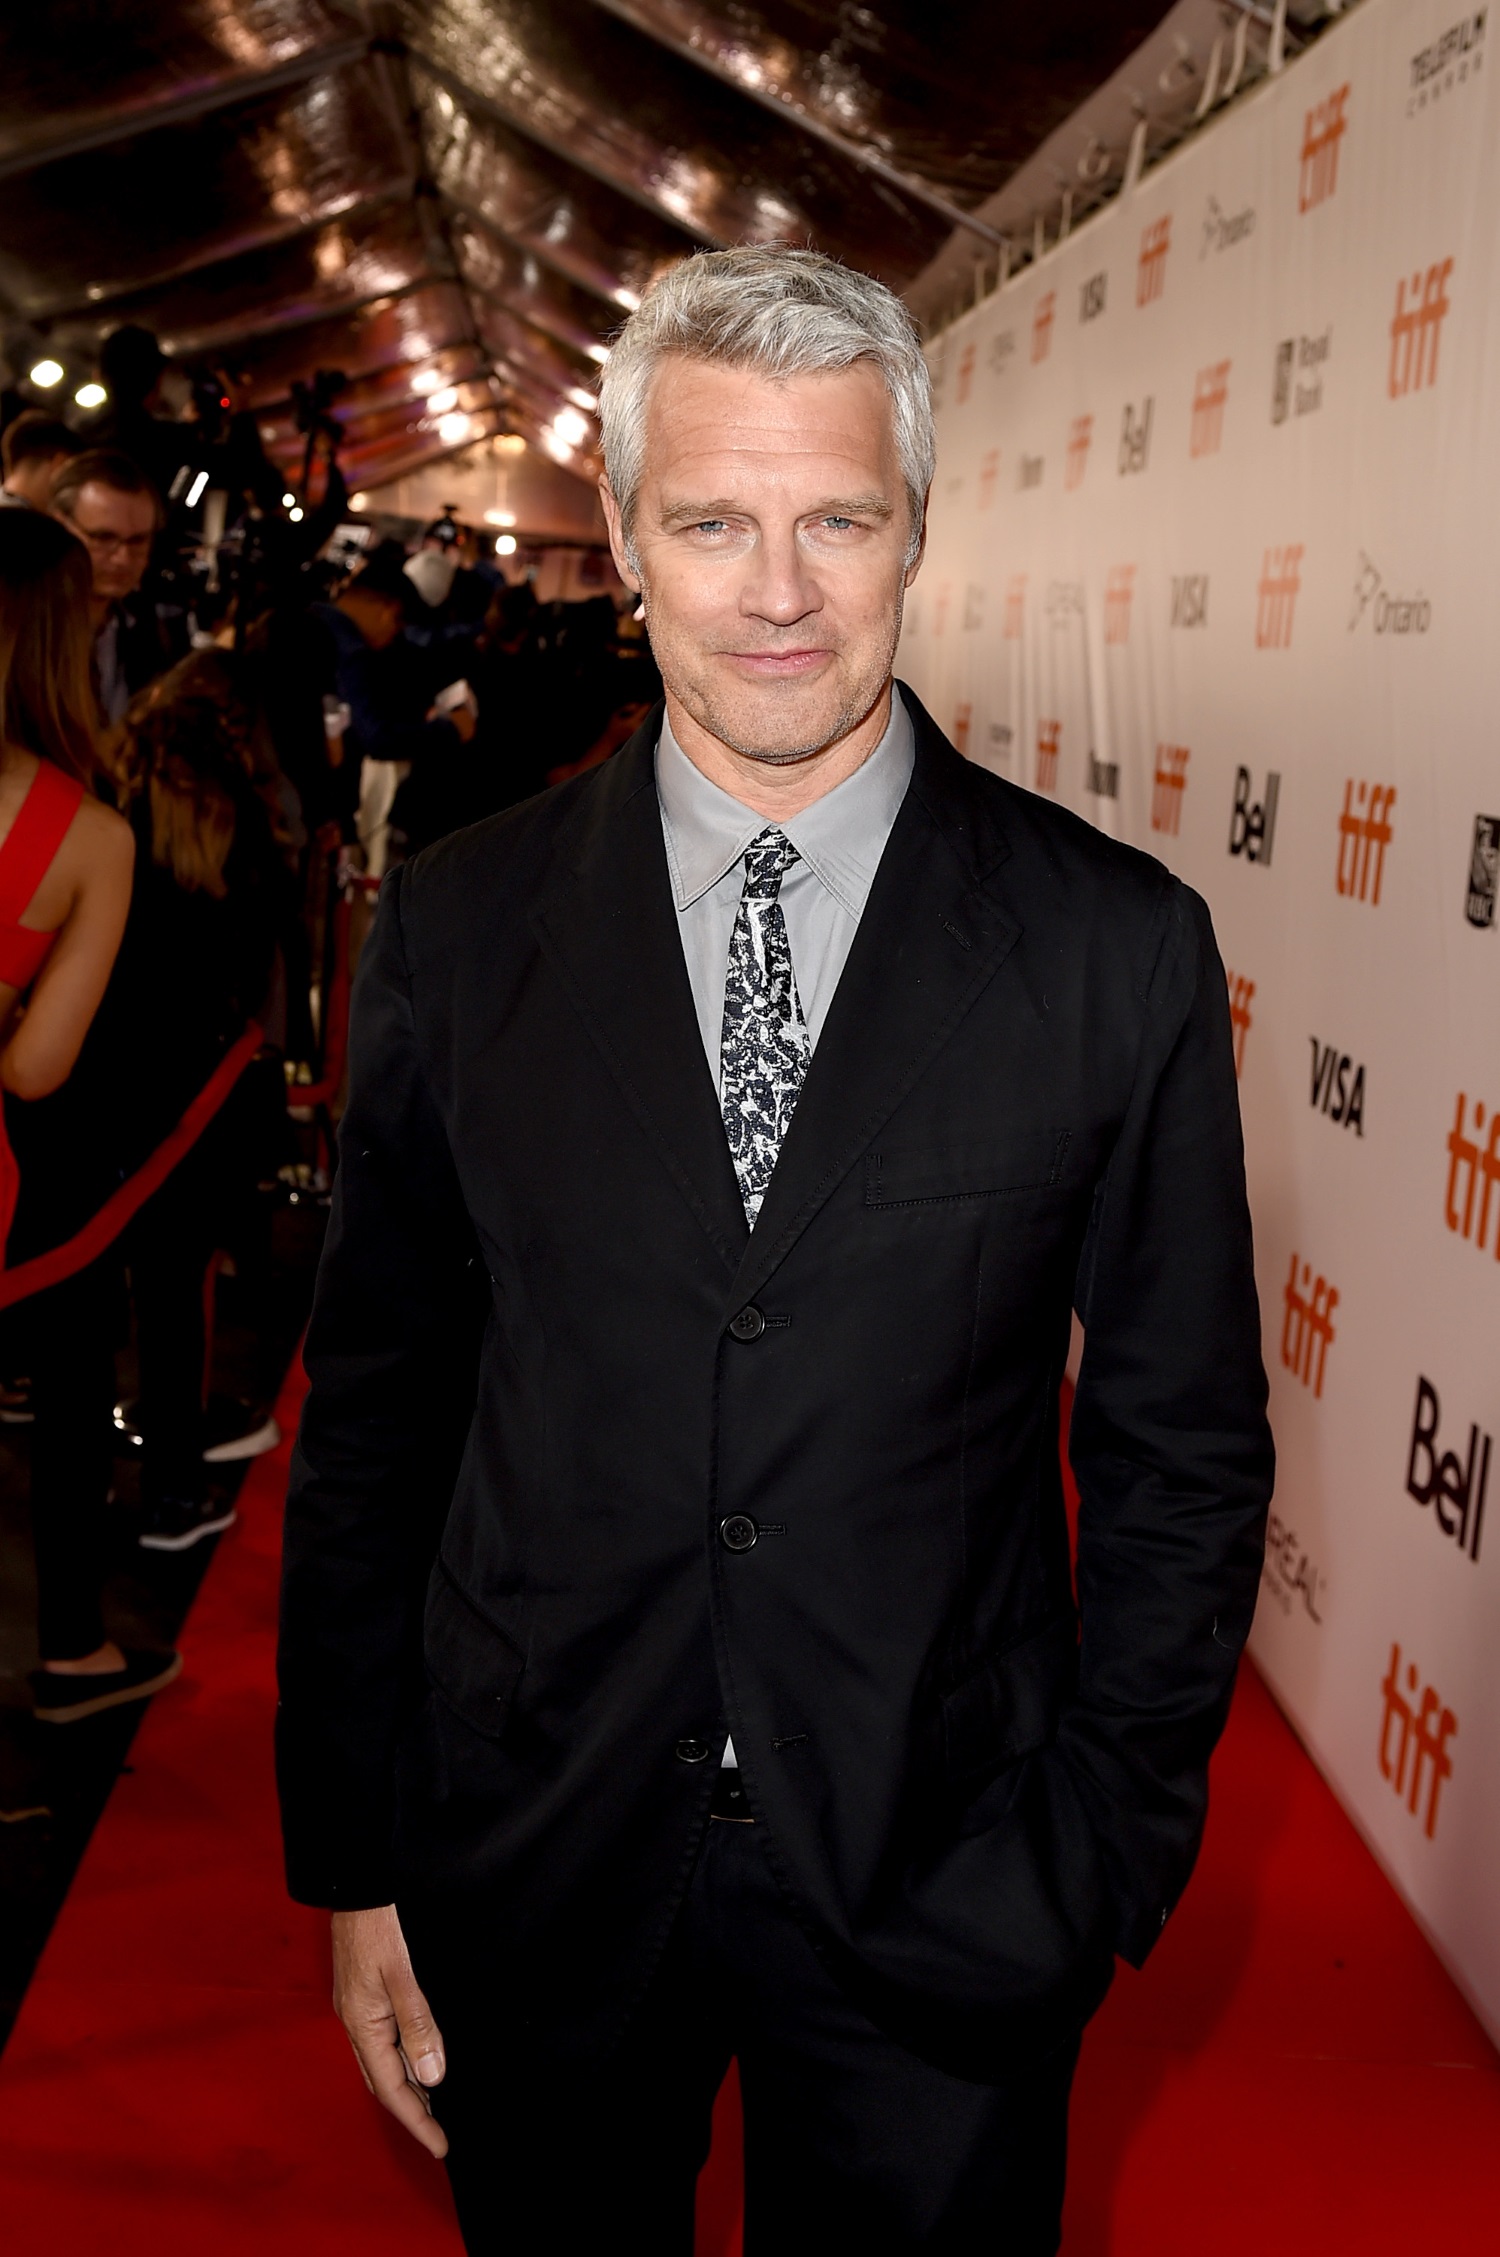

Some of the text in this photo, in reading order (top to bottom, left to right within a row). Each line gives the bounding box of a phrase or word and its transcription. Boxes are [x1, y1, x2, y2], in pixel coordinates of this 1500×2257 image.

[1299, 81, 1352, 215] tiff
[1390, 256, 1455, 401] tiff
[1255, 544, 1305, 650] tiff
[1373, 590, 1432, 635] Ontario
[1227, 763, 1281, 868] Bell
[1336, 777, 1398, 908] tiff
[1227, 968, 1256, 1080] ff
[1308, 1034, 1367, 1139] VISA
[1445, 1091, 1500, 1264] tif
[1281, 1252, 1339, 1400] tiff
[1405, 1373, 1494, 1564] Bell
[1378, 1641, 1459, 1840] tiff
